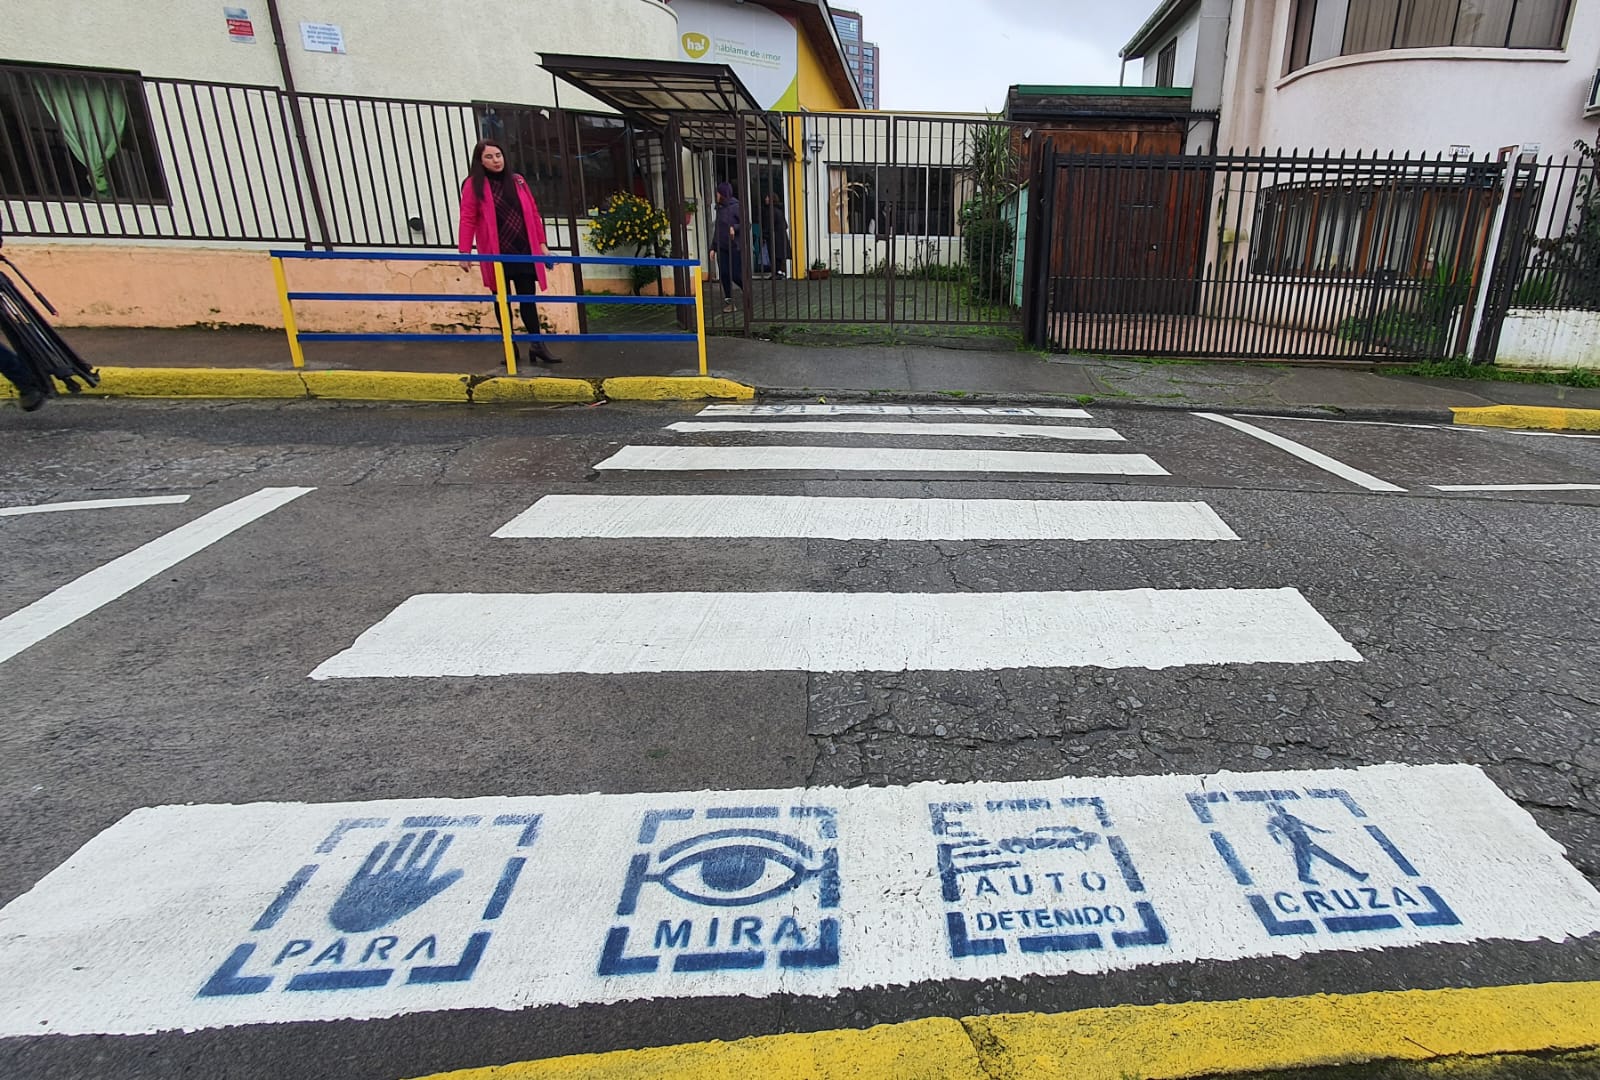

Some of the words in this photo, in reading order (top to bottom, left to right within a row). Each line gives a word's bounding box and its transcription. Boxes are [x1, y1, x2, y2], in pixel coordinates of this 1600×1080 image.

[686, 37, 706, 51] ha!
[715, 43, 750, 57] háblame
[750, 49, 761, 57] de
[975, 871, 1107, 896] AUTO
[1274, 886, 1421, 915] CRUZA
[976, 904, 1126, 932] DETENIDO
[652, 914, 807, 951] MIRA
[272, 932, 438, 967] PARA
